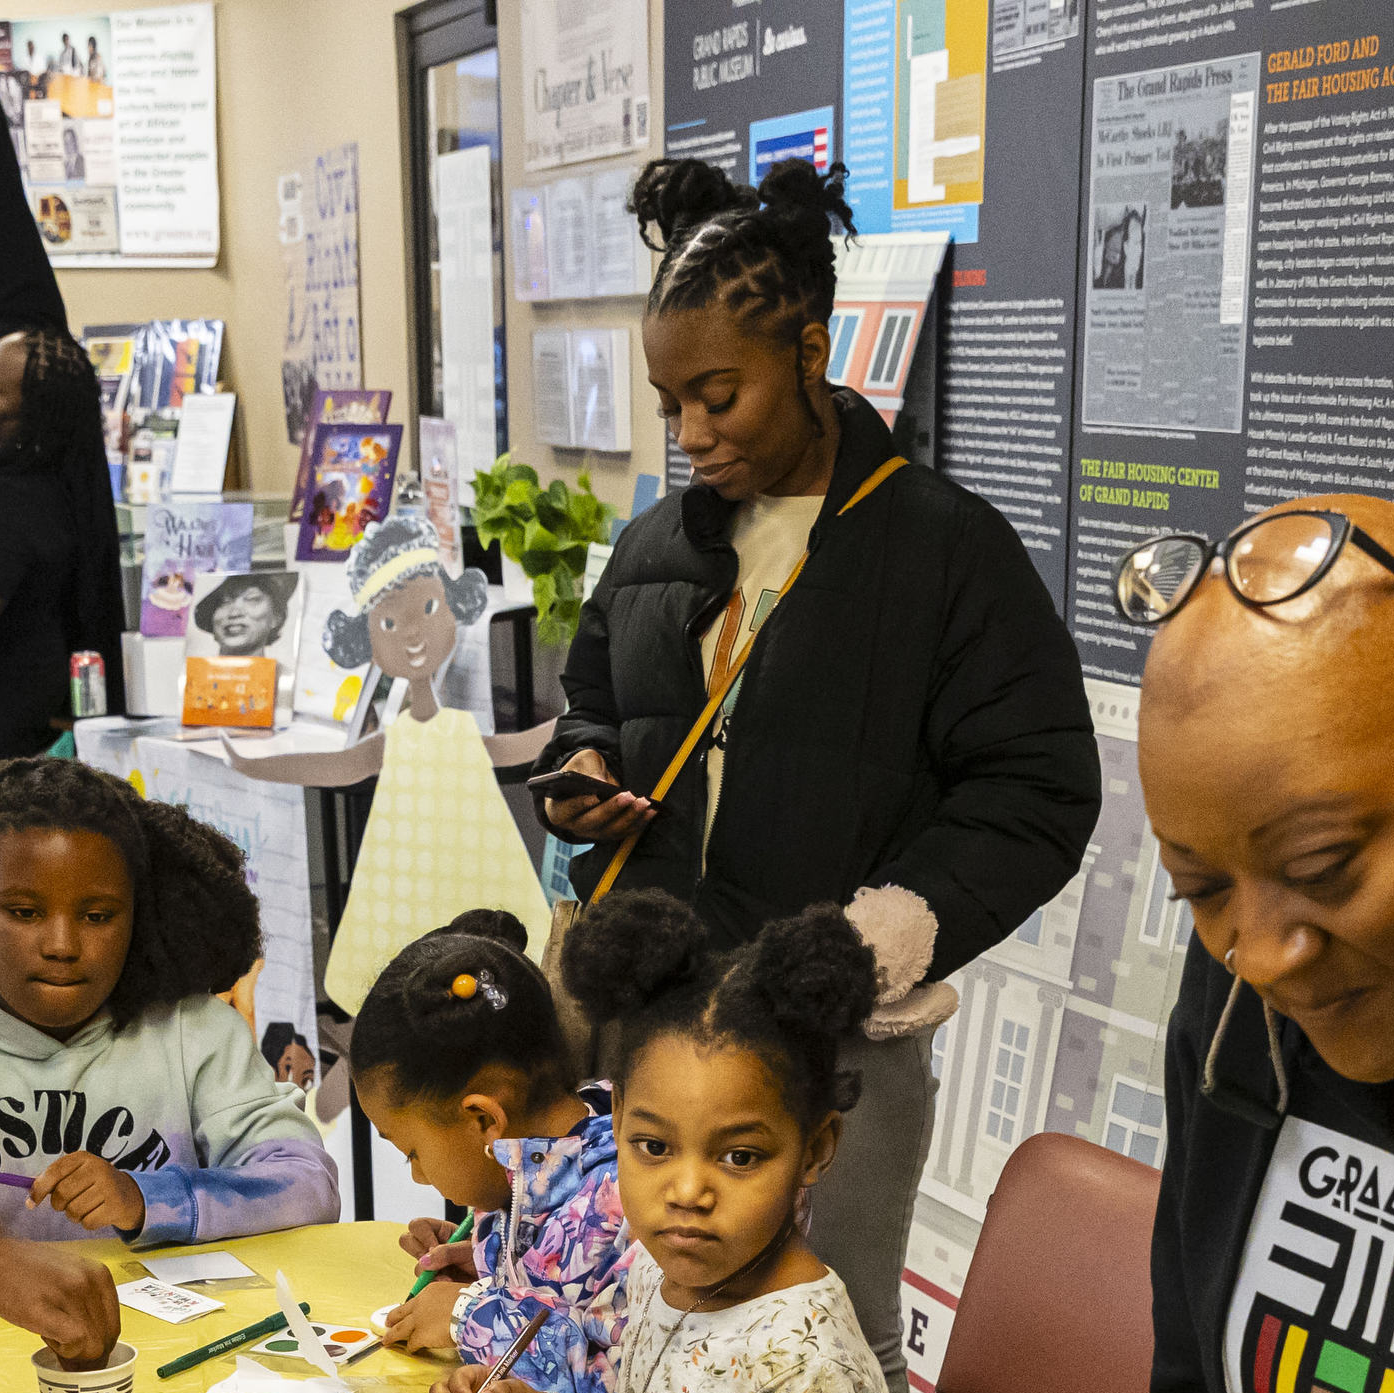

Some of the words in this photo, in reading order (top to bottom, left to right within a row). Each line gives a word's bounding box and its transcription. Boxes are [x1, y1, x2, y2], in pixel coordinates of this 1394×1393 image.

[692, 30, 721, 61] GRAND
[722, 21, 749, 52] RAPIDS
[1268, 46, 1314, 73] GERALD
[1316, 40, 1350, 66] FORD
[1351, 35, 1380, 60] AND
[692, 61, 718, 90] PUBLIC
[719, 54, 754, 84] MUSEUM
[1118, 81, 1135, 101] The
[1137, 73, 1167, 97] Grand
[1169, 69, 1203, 93] Rapids
[1206, 66, 1232, 88] Press
[1266, 81, 1290, 104] THE
[1292, 77, 1320, 101] FAIR
[1321, 67, 1380, 96] HOUSING
[1080, 458, 1101, 477] THE
[1102, 460, 1126, 479] FAIR
[1127, 462, 1176, 484] HOUSING
[1177, 467, 1219, 489] CENTER
[1079, 484, 1094, 502] OF
[1094, 485, 1131, 506] GRAND
[1132, 489, 1170, 511] RAPIDS
[208, 1343, 224, 1353] Marker
[231, 1333, 246, 1343] Edible
[907, 1308, 930, 1357] E
